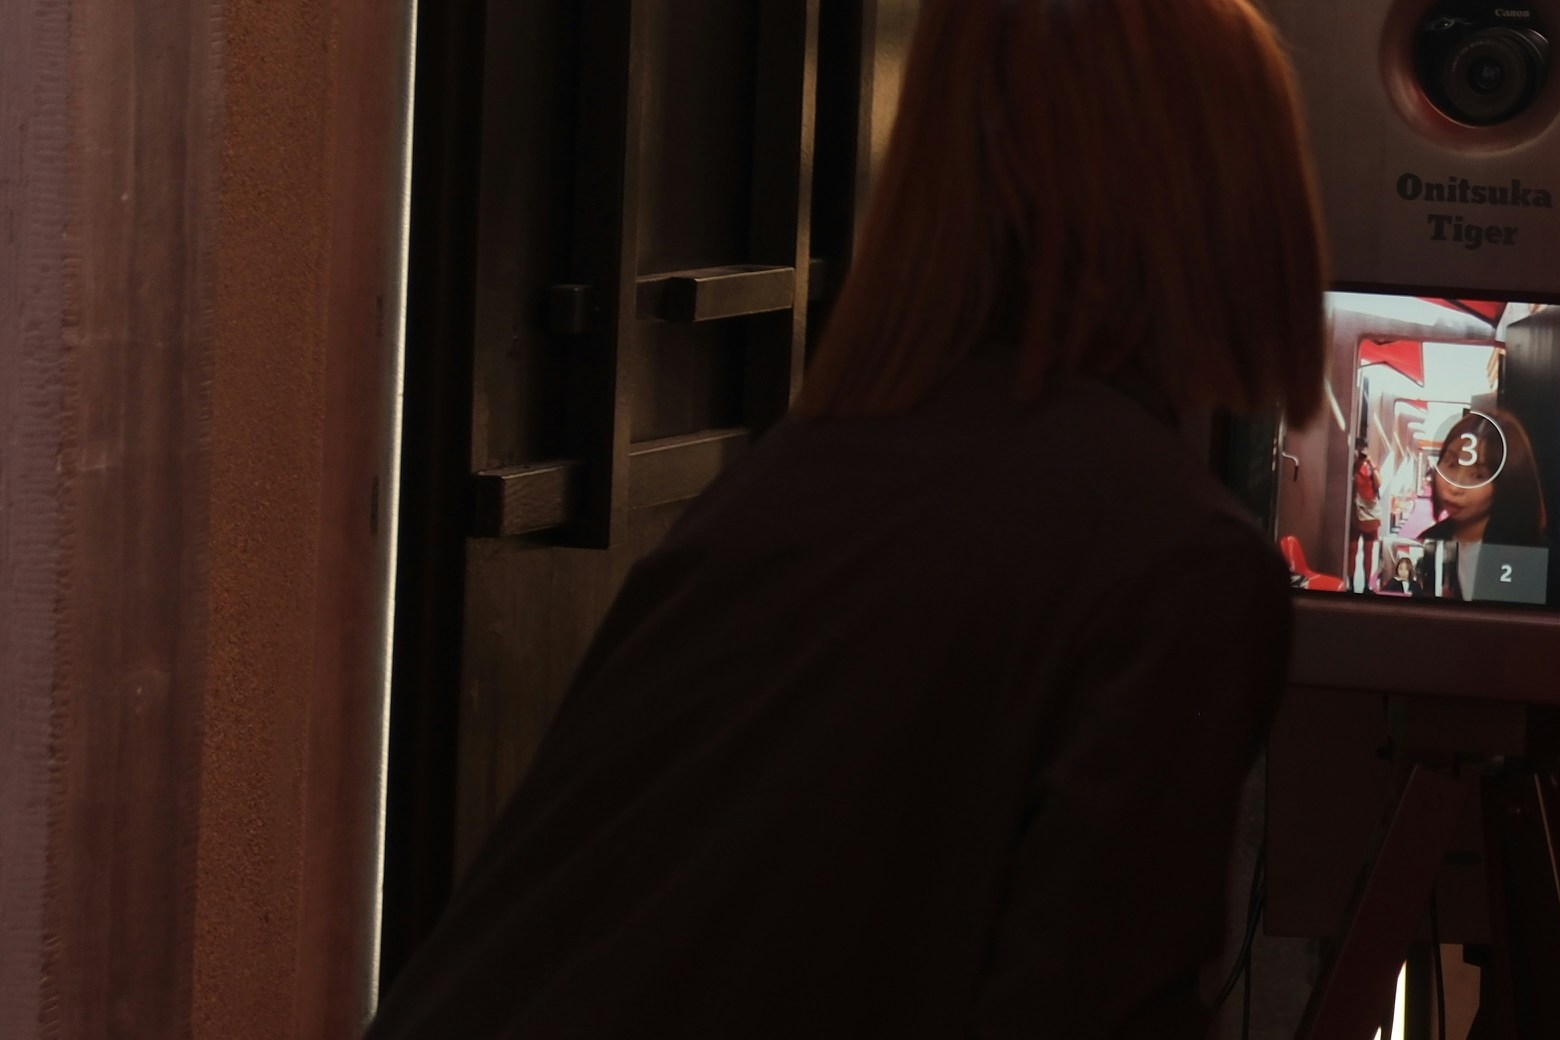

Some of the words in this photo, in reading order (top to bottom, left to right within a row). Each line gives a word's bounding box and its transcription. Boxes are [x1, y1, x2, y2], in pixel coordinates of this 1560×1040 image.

[1494, 7, 1531, 19] Canon
[1396, 172, 1553, 209] Onitsuka
[1427, 214, 1518, 251] Tiger
[1458, 433, 1478, 466] 3
[1500, 565, 1512, 583] 2
